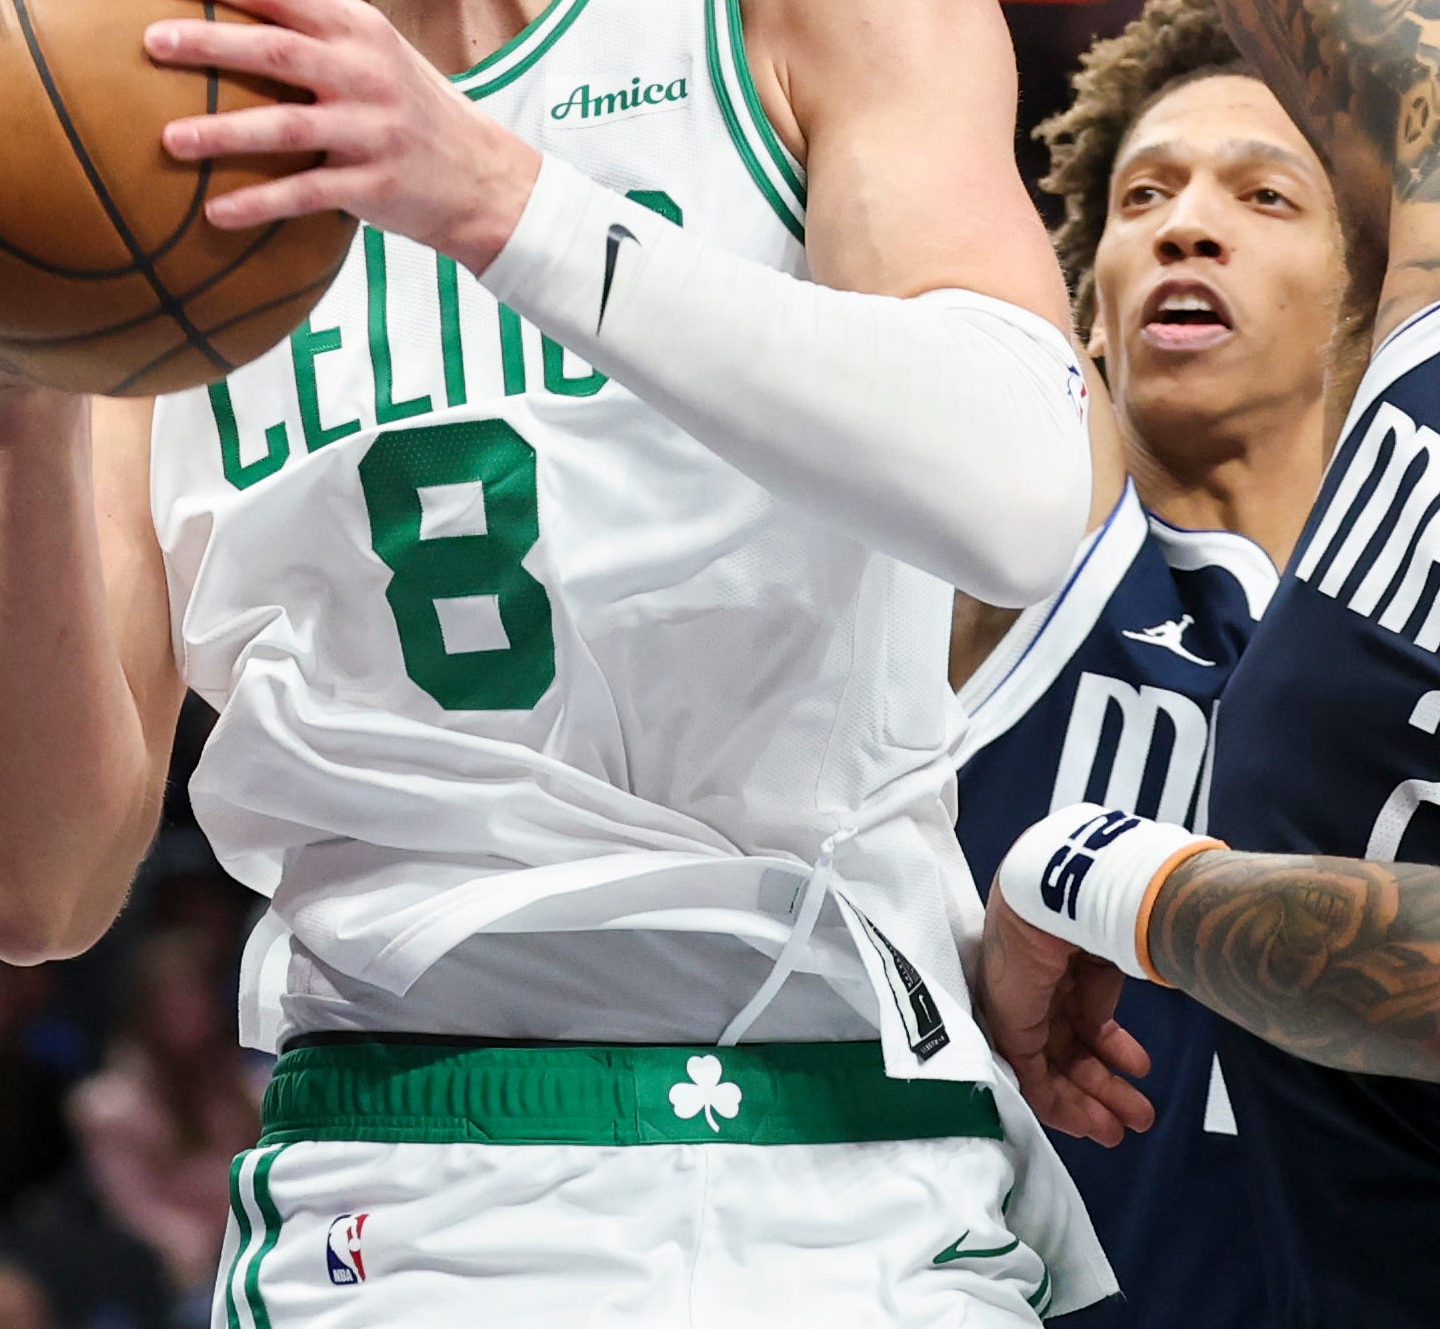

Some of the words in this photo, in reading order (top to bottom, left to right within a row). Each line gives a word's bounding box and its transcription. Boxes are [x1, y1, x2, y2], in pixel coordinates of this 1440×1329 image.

[550, 76, 689, 120] Amica
[207, 191, 683, 491] CELTI
[358, 418, 556, 710] 8
[1041, 810, 1142, 921] 25
[332, 1268, 354, 1283] NBA
